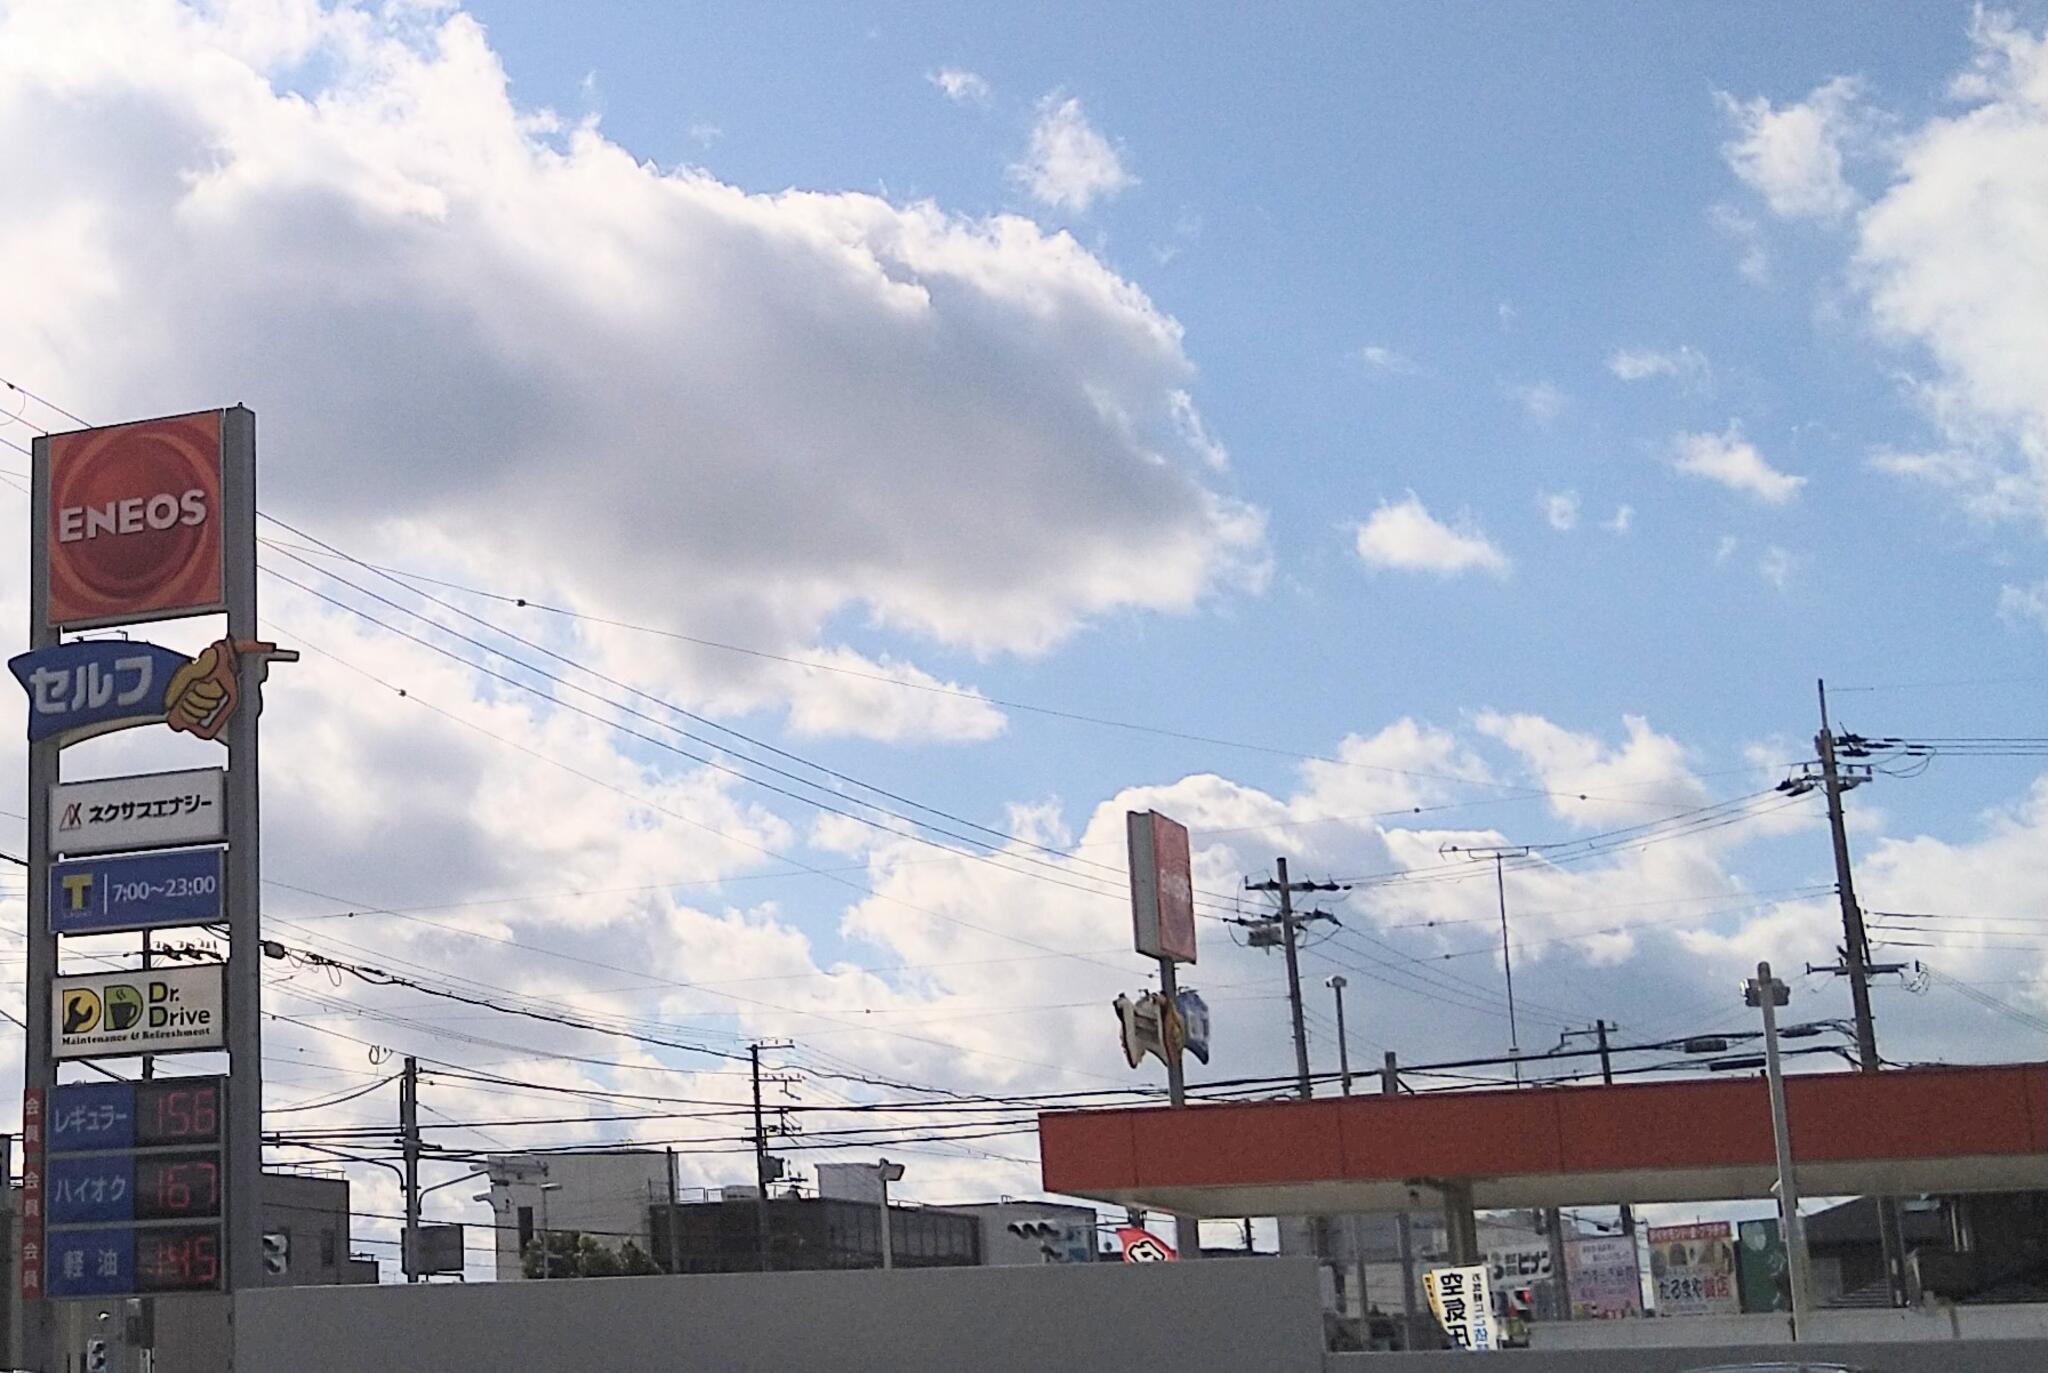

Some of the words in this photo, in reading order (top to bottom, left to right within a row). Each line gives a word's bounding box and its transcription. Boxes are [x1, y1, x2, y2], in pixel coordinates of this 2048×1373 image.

[59, 489, 207, 543] ENEOS
[29, 655, 153, 714] セルフ
[89, 794, 213, 825] ネクサスエナジー
[149, 981, 180, 1004] Dr.
[149, 1006, 211, 1028] Drive
[62, 1034, 127, 1045] Maintenance
[142, 1027, 210, 1040] Refreshment
[55, 1105, 127, 1132] レギュラー
[157, 1088, 216, 1136] 156
[55, 1177, 127, 1203] ハイオク
[157, 1163, 217, 1209] 167
[63, 1249, 118, 1279] 軽油
